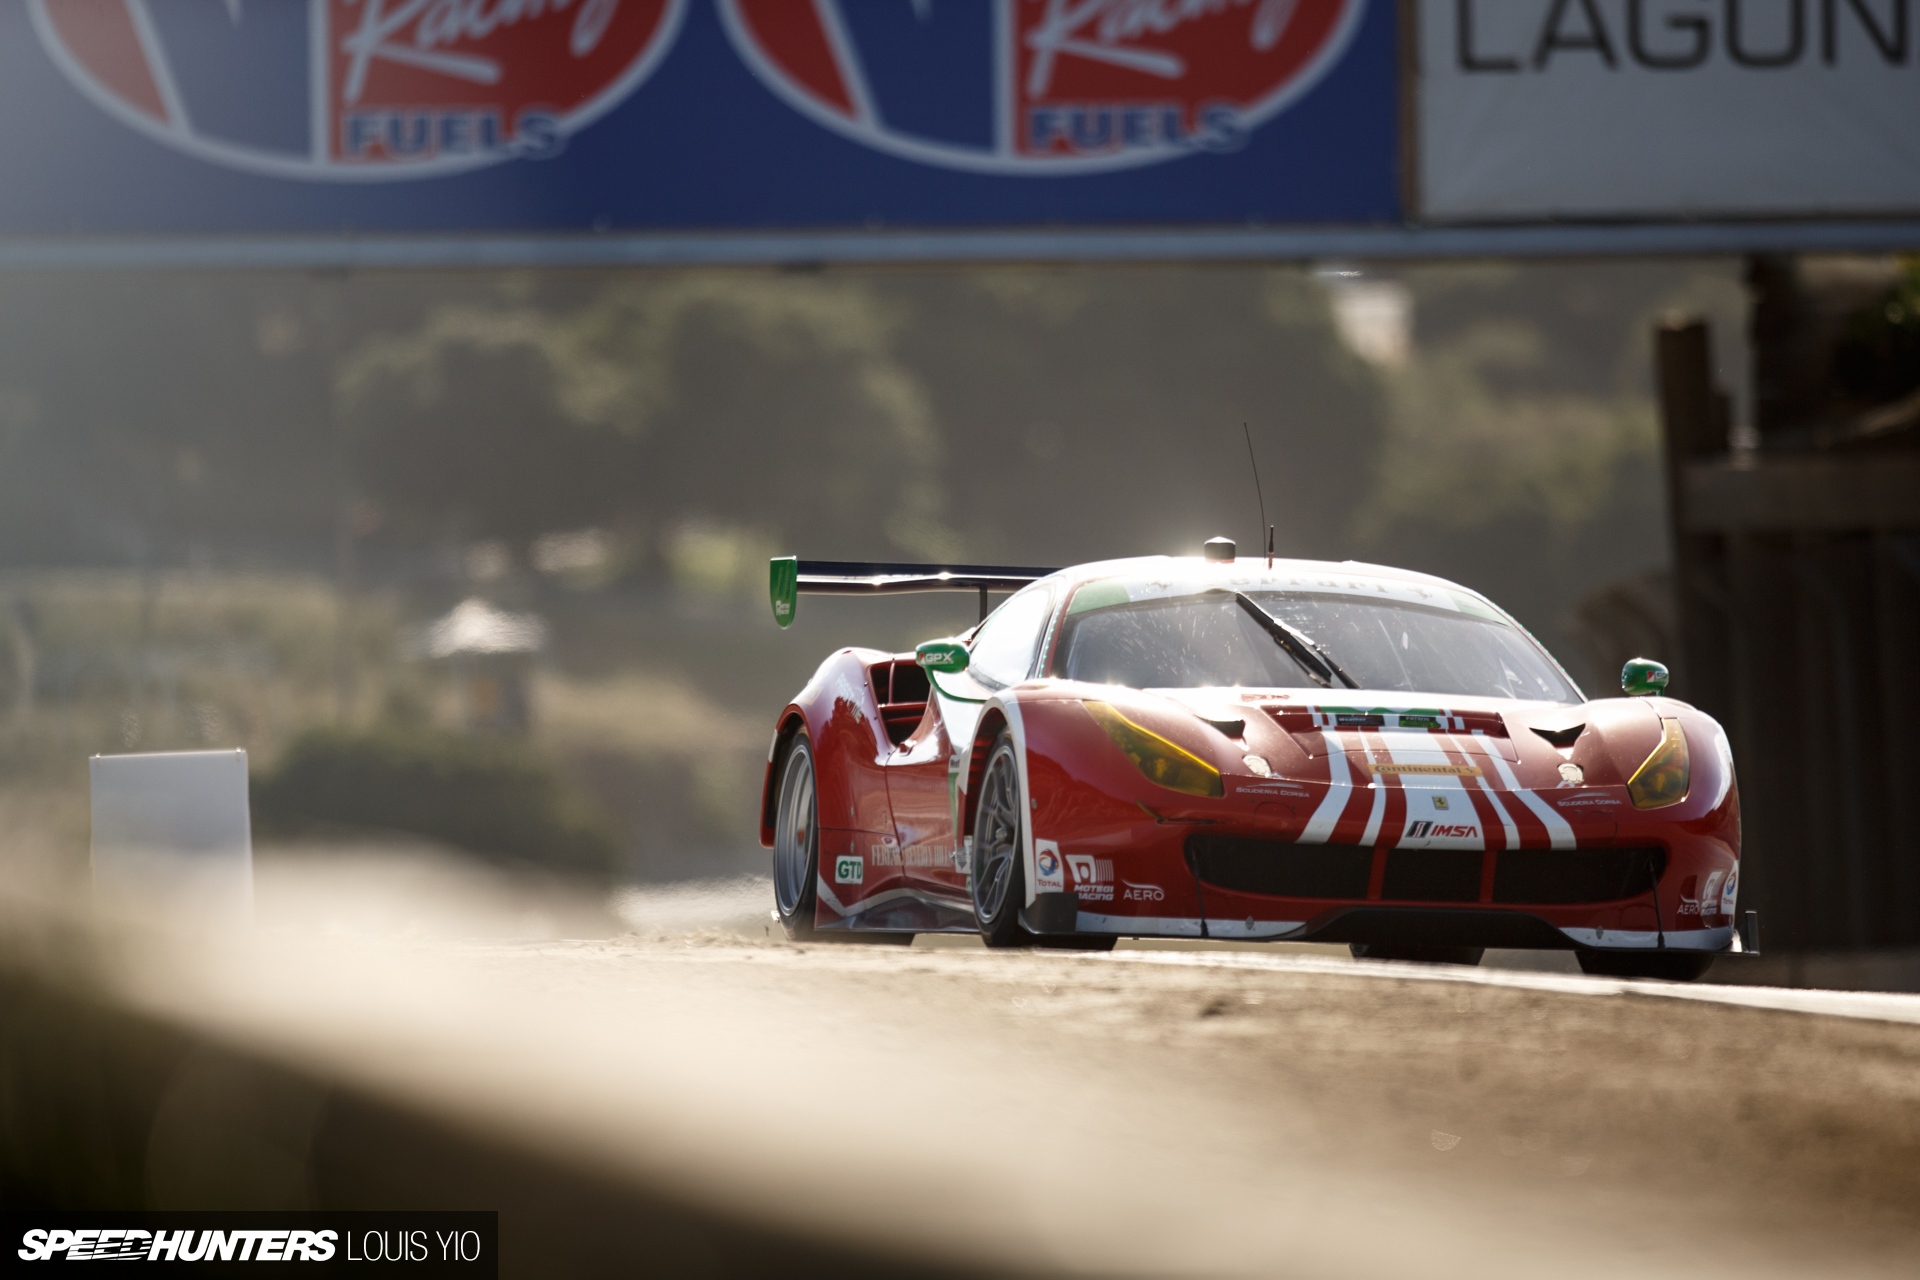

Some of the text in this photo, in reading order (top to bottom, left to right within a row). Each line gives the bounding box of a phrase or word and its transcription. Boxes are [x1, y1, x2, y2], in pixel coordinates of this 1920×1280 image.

[346, 110, 567, 157] FUELS
[1030, 104, 1246, 151] FUELS
[925, 651, 955, 663] GPX
[1374, 765, 1462, 774] Continental
[1430, 825, 1478, 838] IMSA
[838, 860, 862, 880] GTD
[1037, 879, 1062, 888] TOTAL
[1074, 884, 1114, 893] MOTEGI
[1123, 889, 1165, 901] AERO
[1677, 904, 1700, 915] AERO
